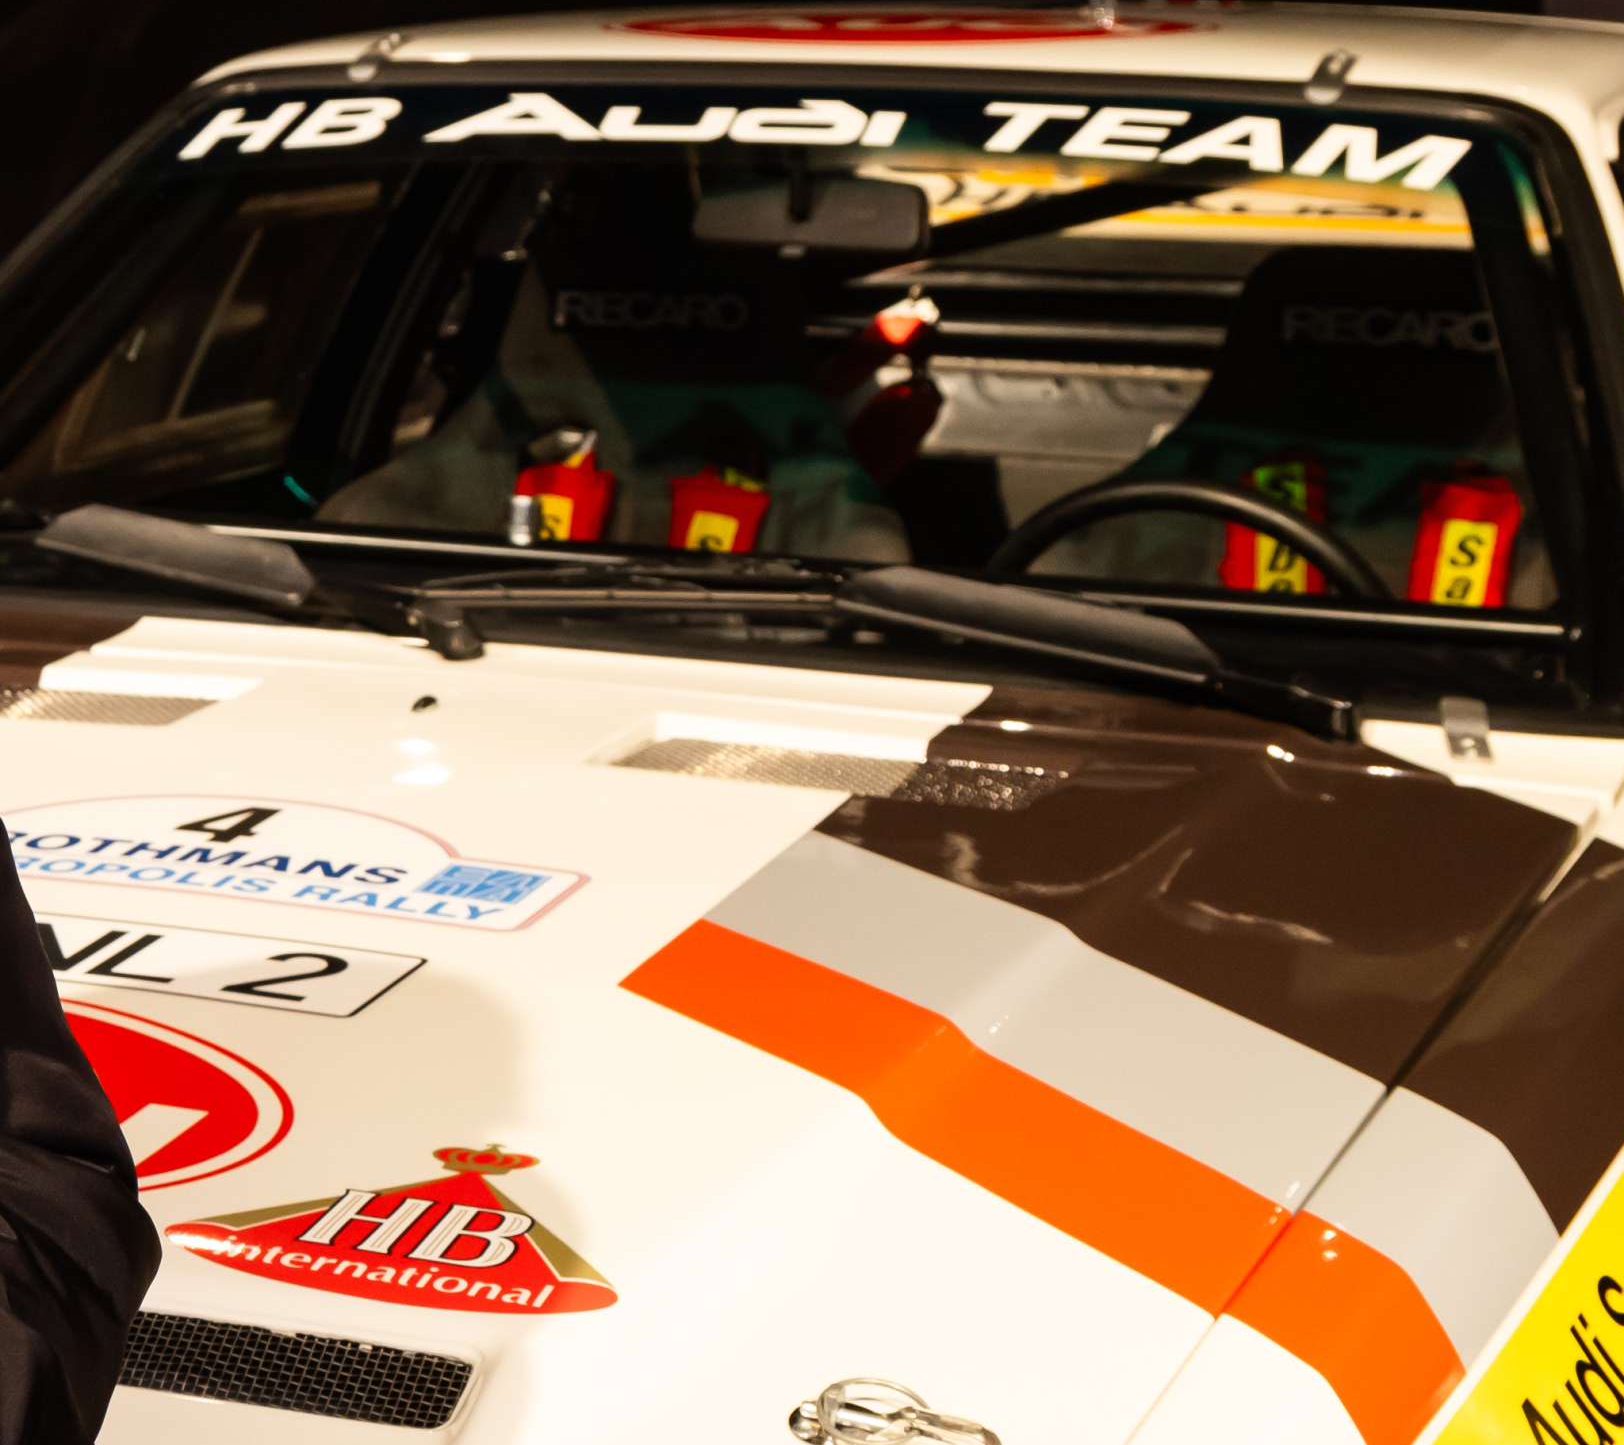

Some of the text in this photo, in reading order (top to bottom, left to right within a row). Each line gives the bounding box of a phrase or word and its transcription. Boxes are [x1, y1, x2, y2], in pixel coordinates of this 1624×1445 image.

[177, 96, 404, 161] HB
[982, 100, 1475, 191] TEAM
[554, 288, 751, 333] RECARO
[1280, 304, 1500, 353] RECARO
[174, 805, 284, 844] 4
[290, 883, 506, 921] RALLY
[219, 951, 349, 1003] 2
[295, 1188, 536, 1269] HB
[216, 1235, 555, 1310] international
